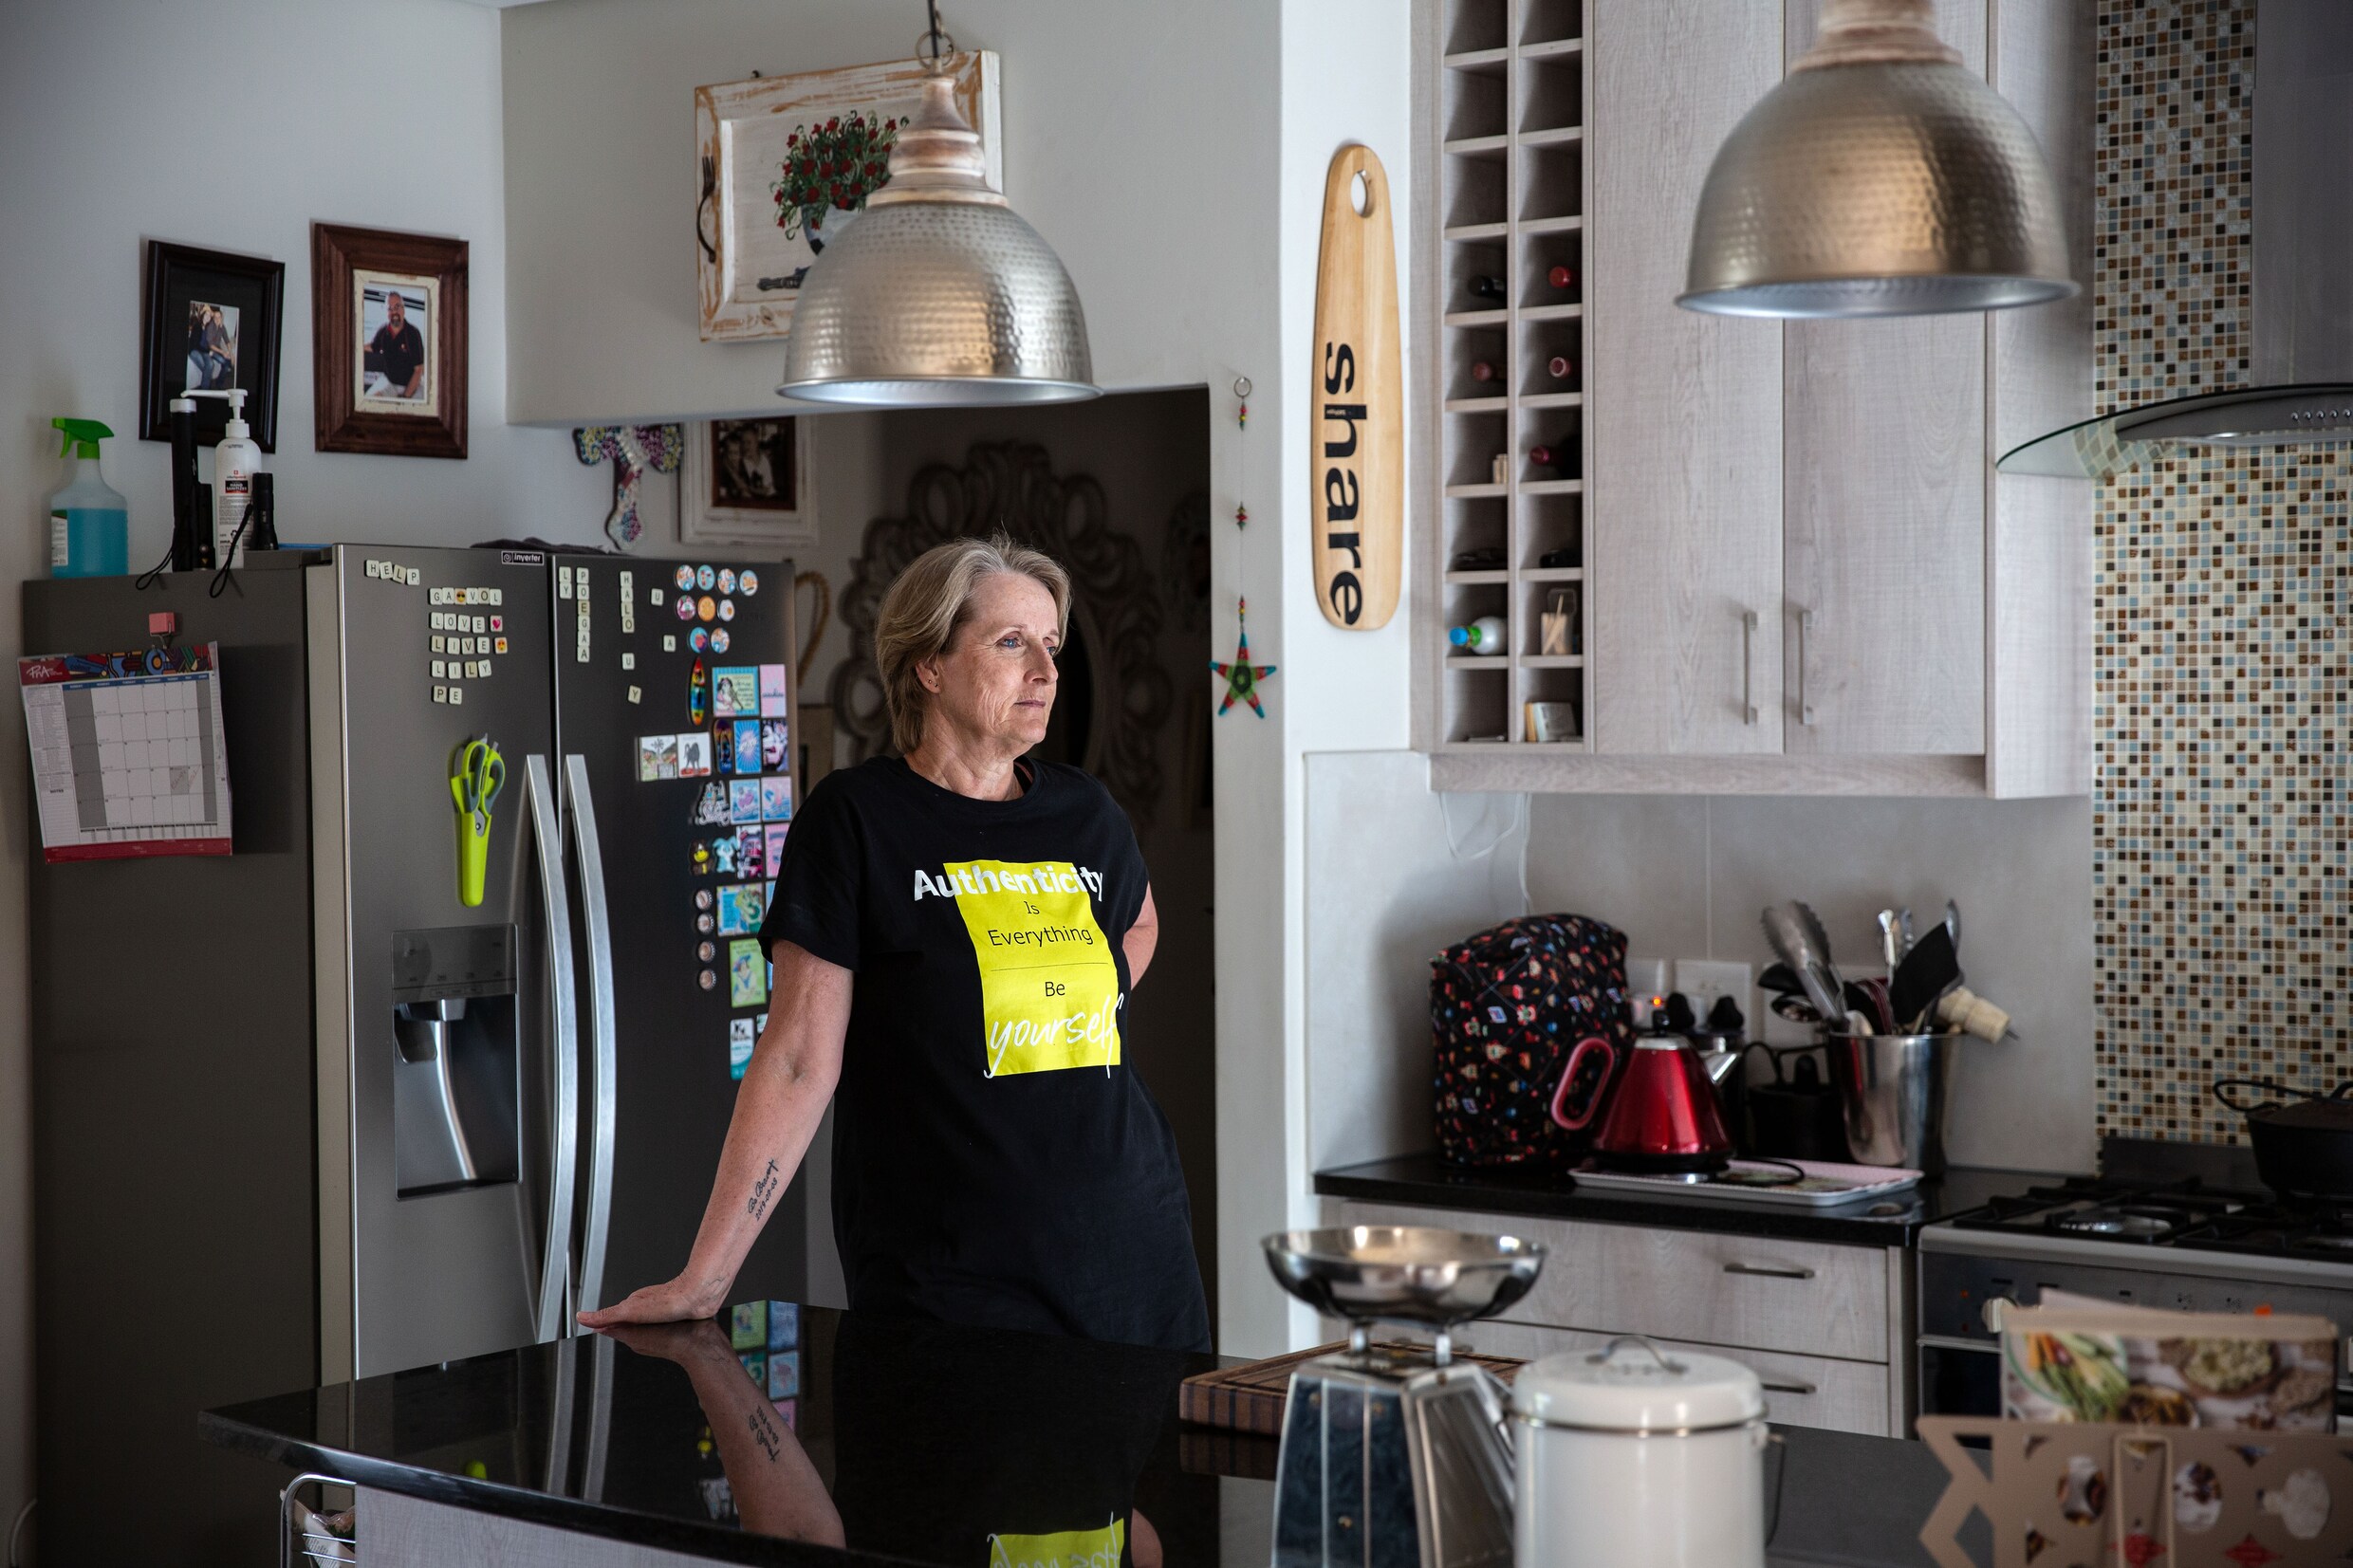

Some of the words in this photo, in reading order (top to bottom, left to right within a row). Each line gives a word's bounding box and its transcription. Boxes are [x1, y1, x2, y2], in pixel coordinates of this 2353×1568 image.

[1325, 341, 1367, 626] share
[368, 563, 418, 582] HELP
[435, 616, 483, 631] LOVE
[434, 638, 488, 653] LIVE
[435, 663, 490, 676] LILY
[435, 687, 460, 702] PE
[914, 865, 1102, 901] Authenticity
[1024, 901, 1040, 914] Is
[988, 926, 1093, 947] Everything
[1045, 981, 1065, 997] Be
[983, 992, 1124, 1079] yourself
